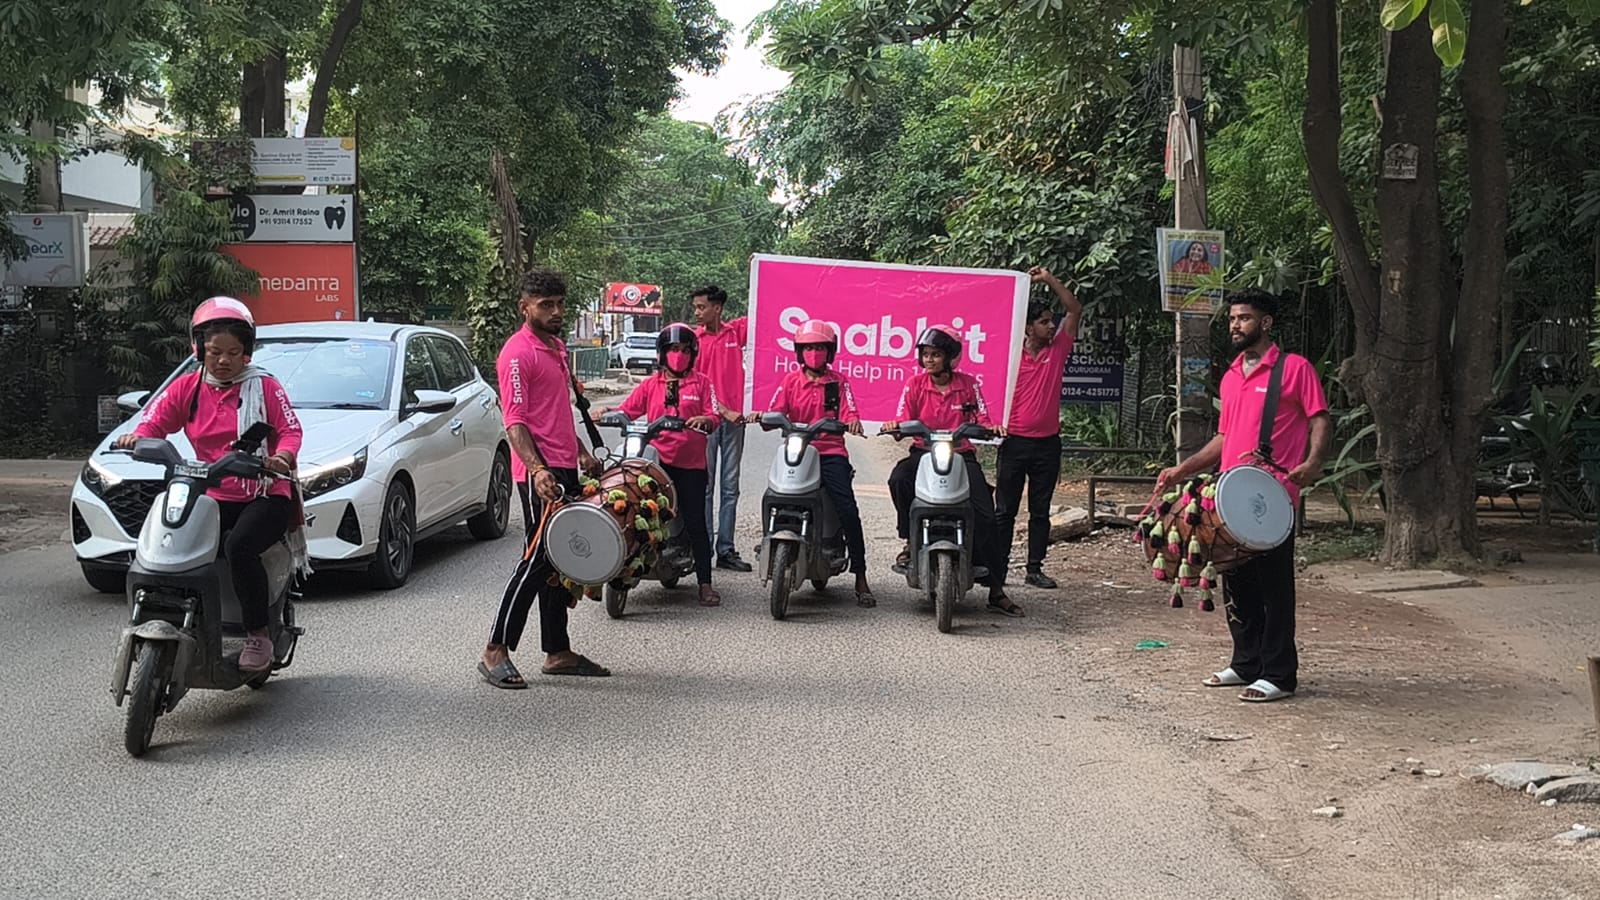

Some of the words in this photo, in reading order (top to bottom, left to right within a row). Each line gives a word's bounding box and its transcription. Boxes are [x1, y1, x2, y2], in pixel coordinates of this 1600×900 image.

[259, 207, 271, 216] Dr.
[272, 207, 295, 216] Amrit
[296, 207, 320, 216] Raina
[292, 217, 313, 226] 17552
[31, 241, 64, 254] earX
[315, 294, 340, 303] LABS
[776, 306, 987, 364] Sabt
[838, 359, 882, 384] Help
[886, 363, 905, 381] in
[1068, 365, 1113, 374] GURUGRAM
[508, 358, 523, 404] Snabbit
